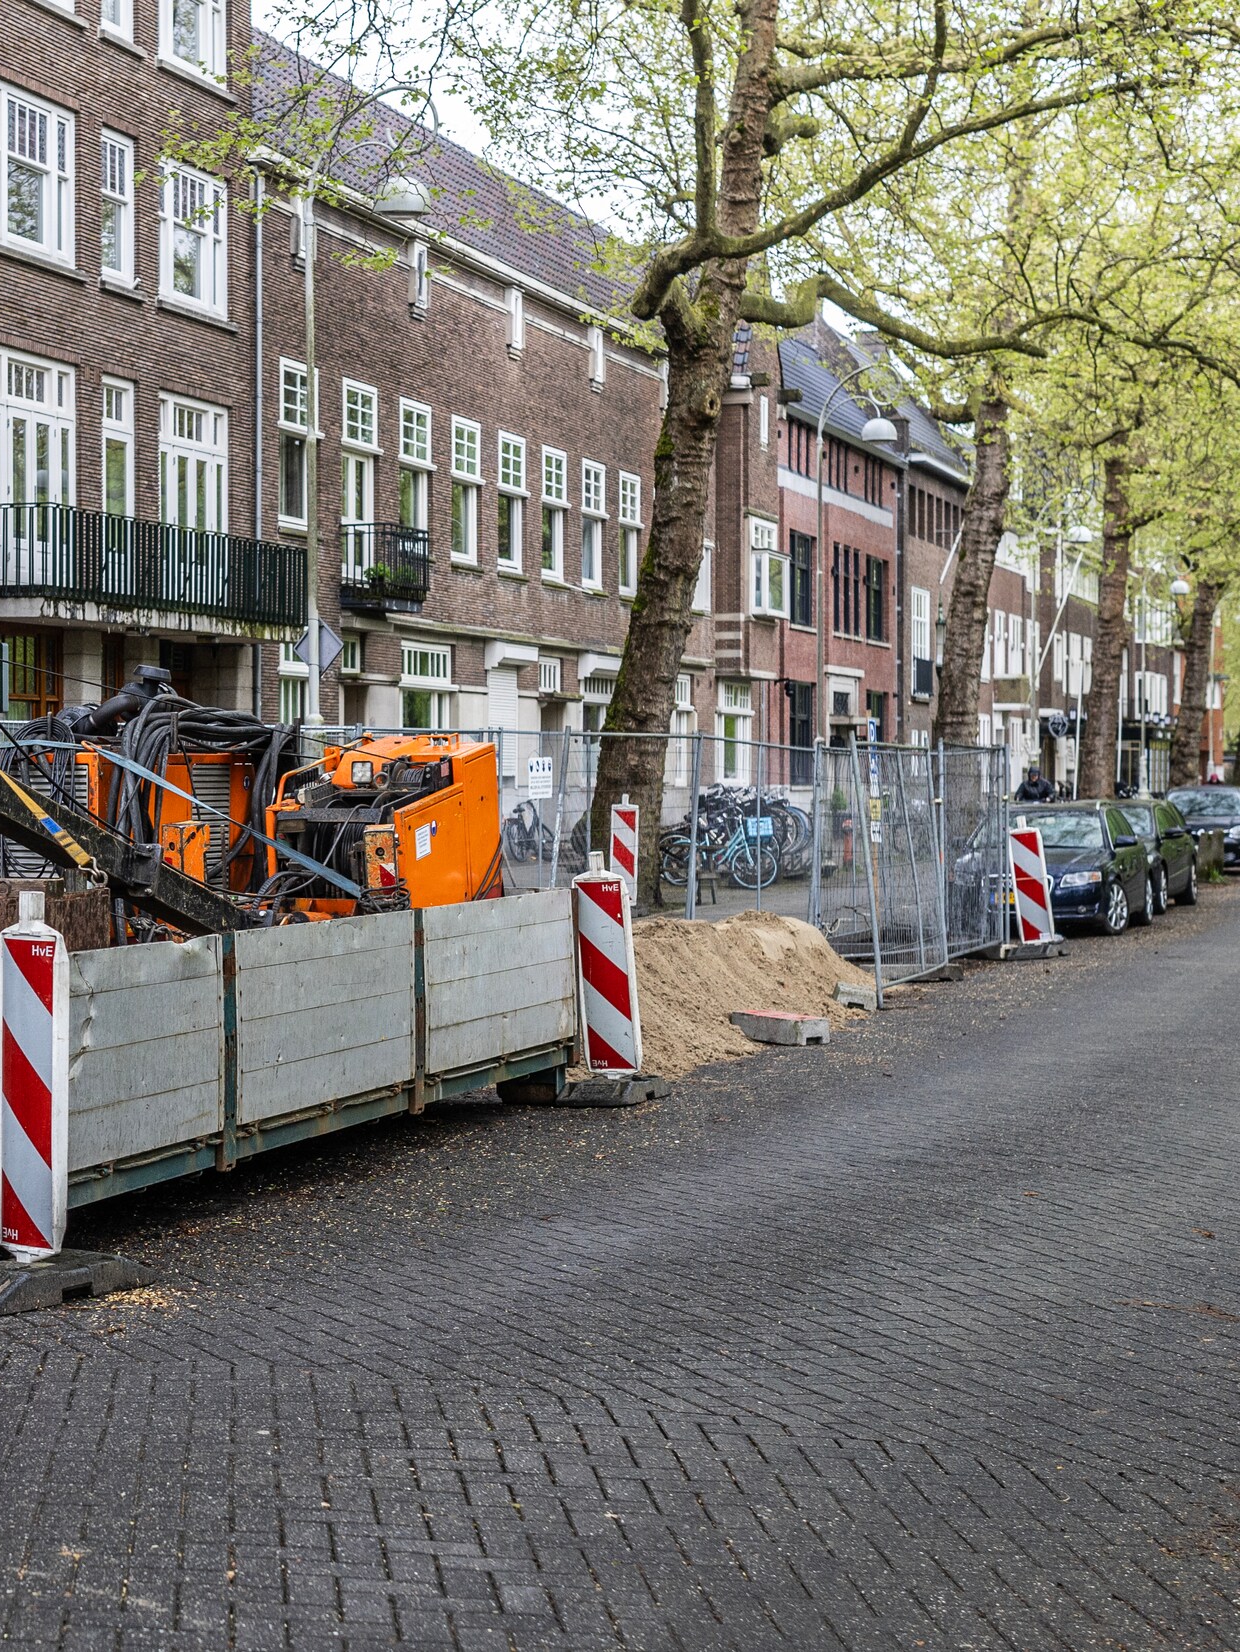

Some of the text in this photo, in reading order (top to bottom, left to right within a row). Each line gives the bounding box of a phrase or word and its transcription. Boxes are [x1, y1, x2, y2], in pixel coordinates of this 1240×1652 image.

[602, 883, 619, 892] HvE
[31, 944, 54, 957] HvE
[592, 1059, 608, 1067] HvE
[2, 1226, 19, 1241] HvE
